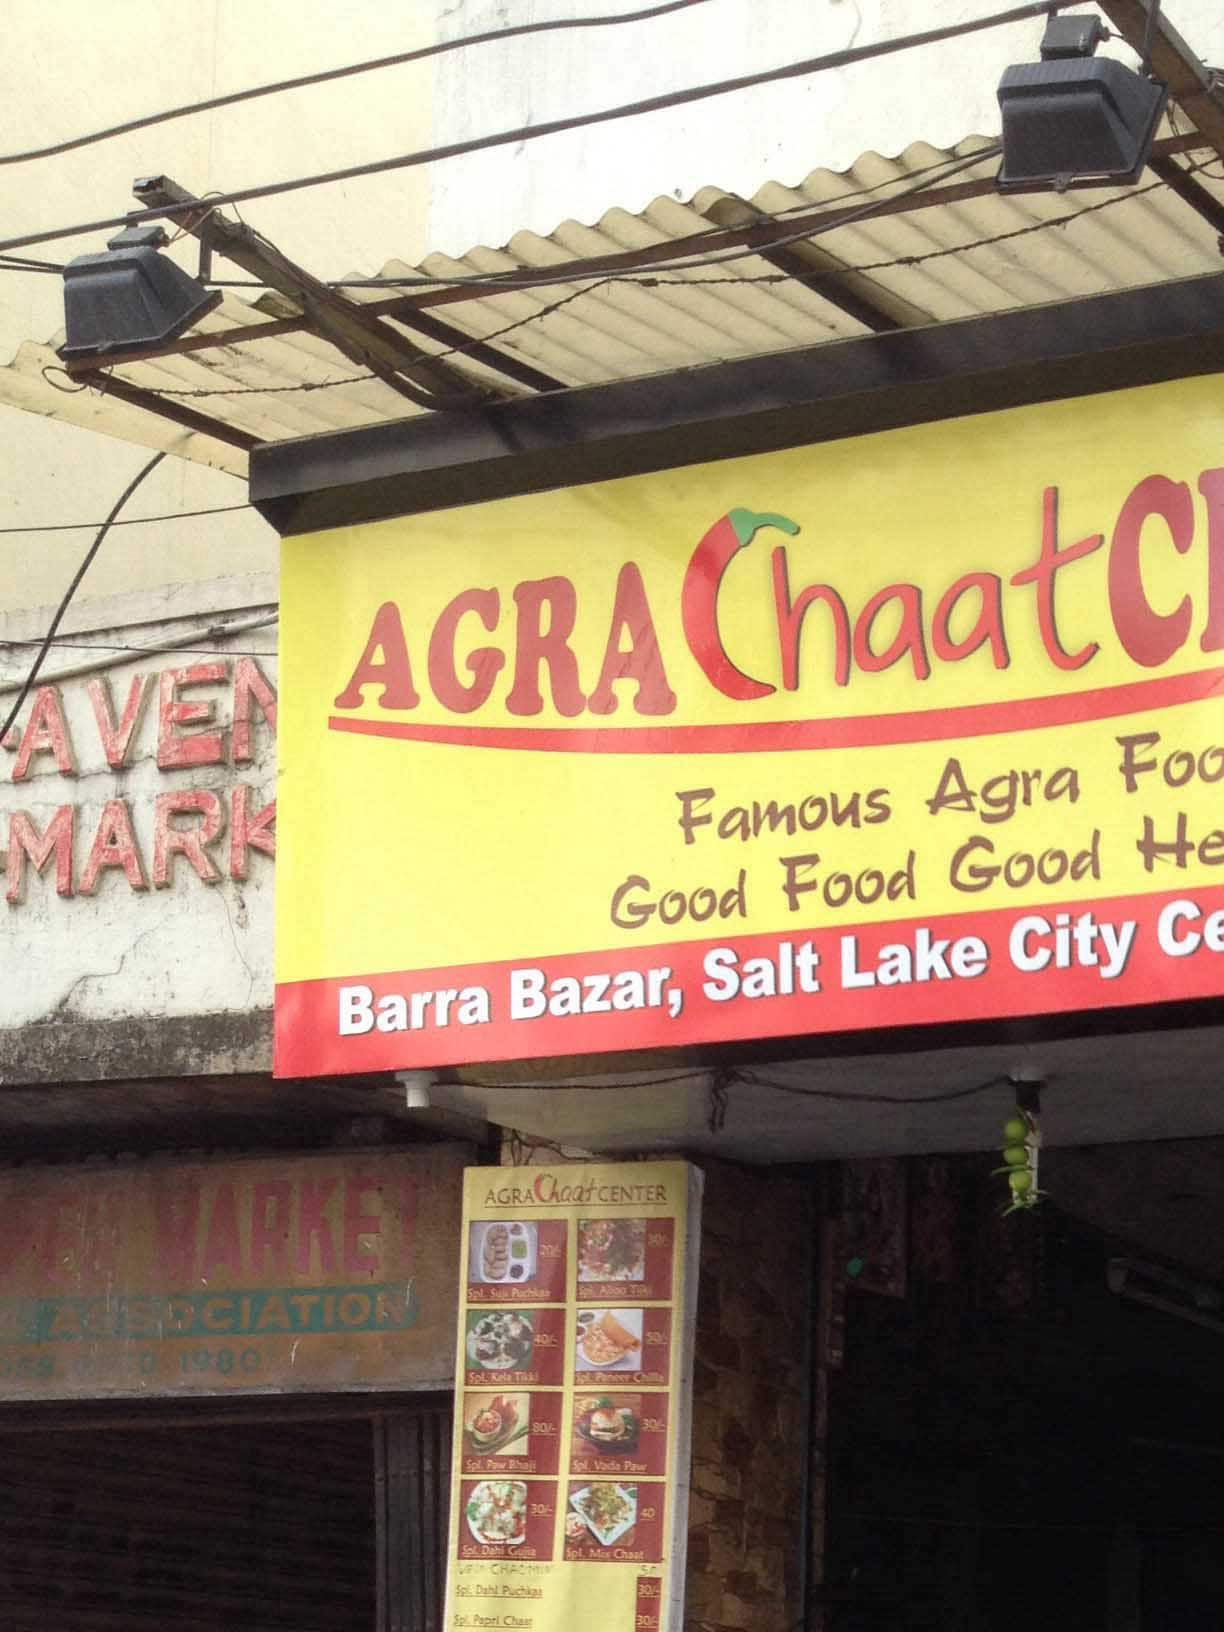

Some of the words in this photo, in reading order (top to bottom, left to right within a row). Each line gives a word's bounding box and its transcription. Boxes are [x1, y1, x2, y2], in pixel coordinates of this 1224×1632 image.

[333, 561, 678, 718] AGRA
[681, 486, 1104, 700] Chaat
[6, 784, 276, 905] MARK
[676, 786, 892, 845] Famous
[925, 757, 1081, 826] Agra
[610, 867, 748, 930] Good
[779, 850, 916, 912] Food
[948, 830, 1102, 895] Good
[336, 984, 491, 1036] Barra
[507, 961, 684, 1021] Bazar,
[702, 941, 820, 1001] Salt
[840, 928, 987, 989] Lake
[1008, 905, 1138, 979] City
[485, 1187, 535, 1204] AGRA
[534, 1173, 599, 1203] Chaat
[600, 1184, 667, 1201] CENTER
